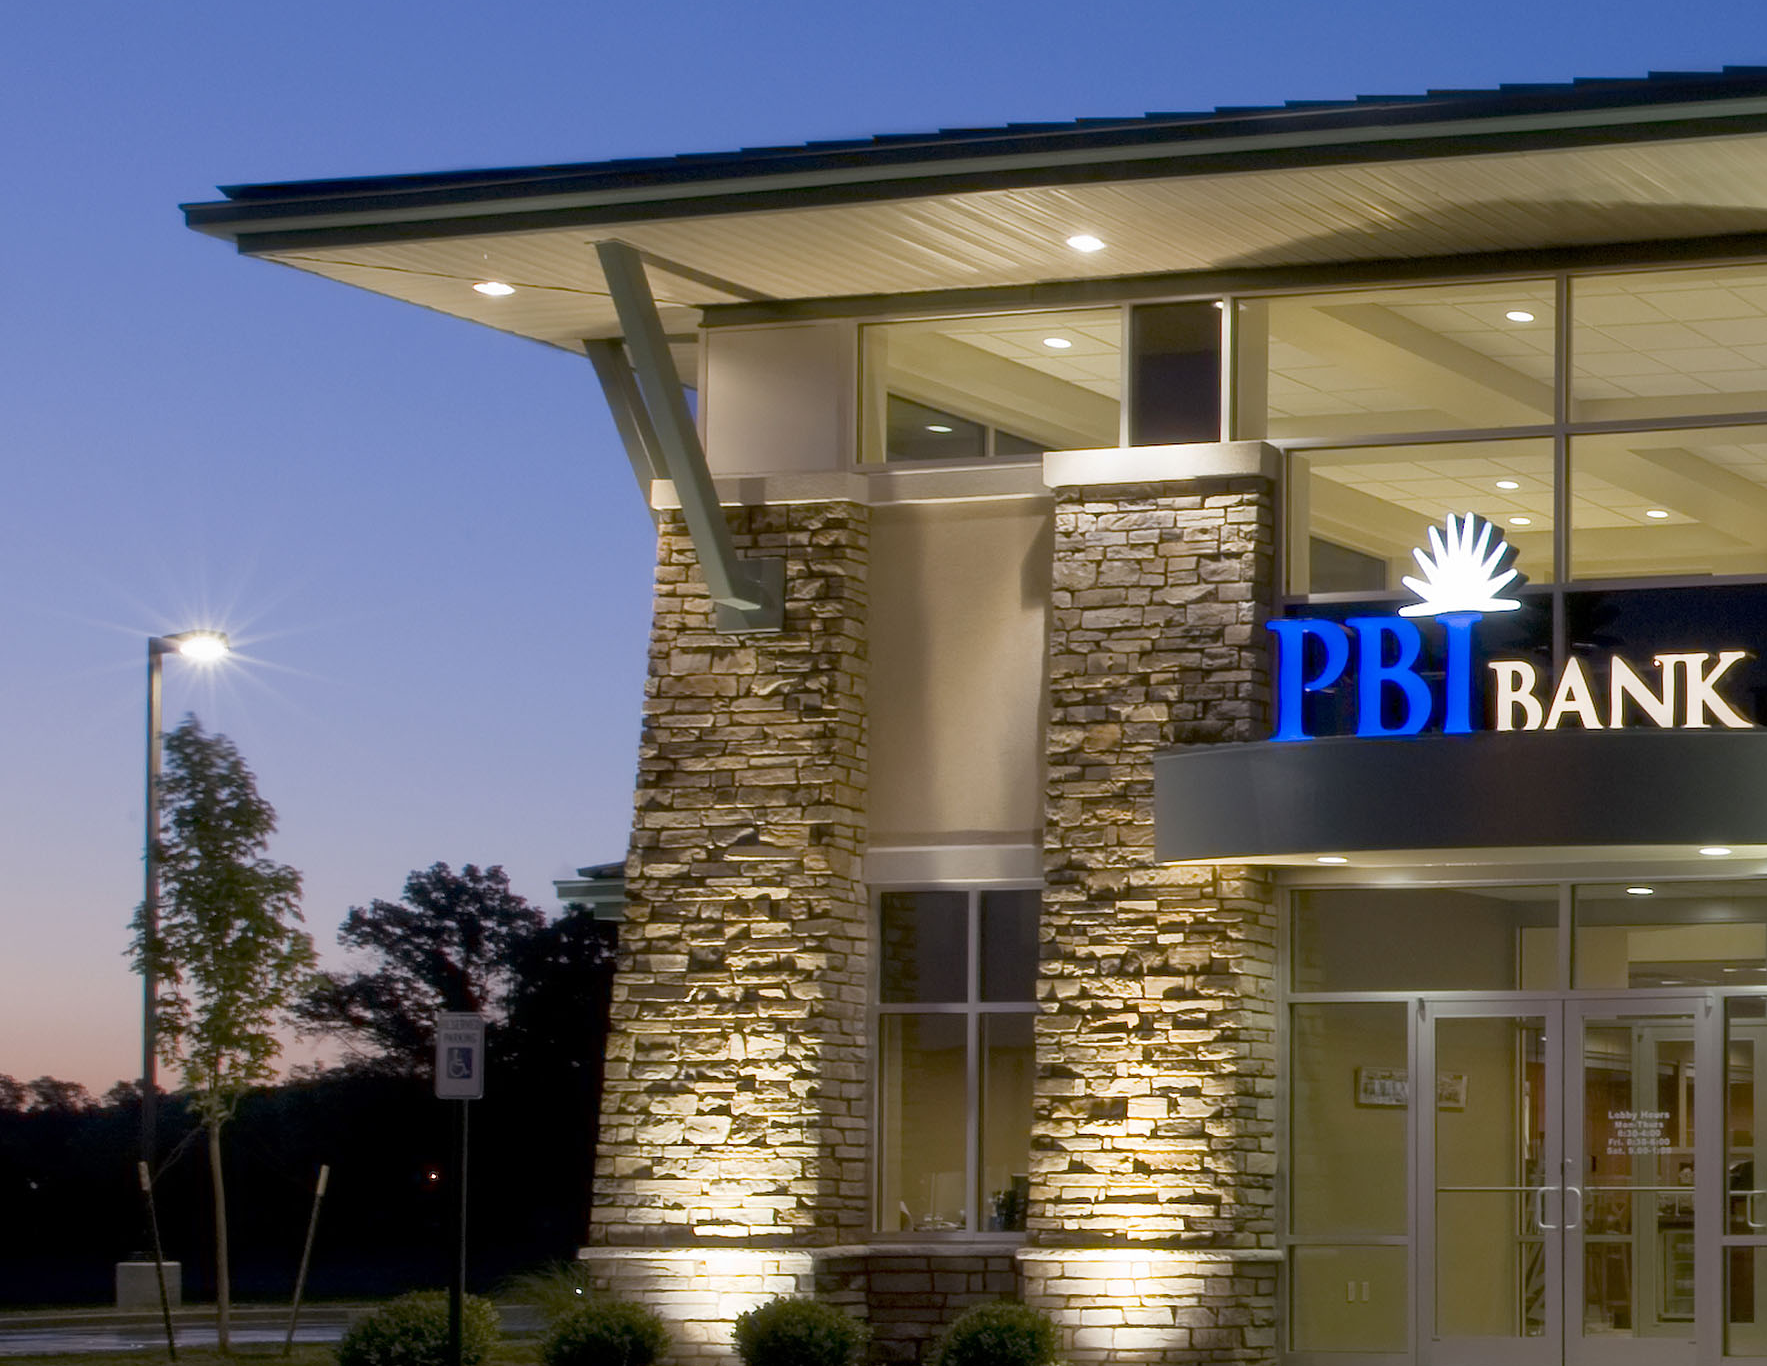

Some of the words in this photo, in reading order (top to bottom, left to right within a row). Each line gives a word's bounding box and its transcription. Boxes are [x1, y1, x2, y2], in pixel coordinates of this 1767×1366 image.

[1266, 614, 1482, 742] PBI
[1488, 650, 1755, 731] BANK
[1608, 1111, 1637, 1121] Lobby
[1640, 1111, 1670, 1119] Hours
